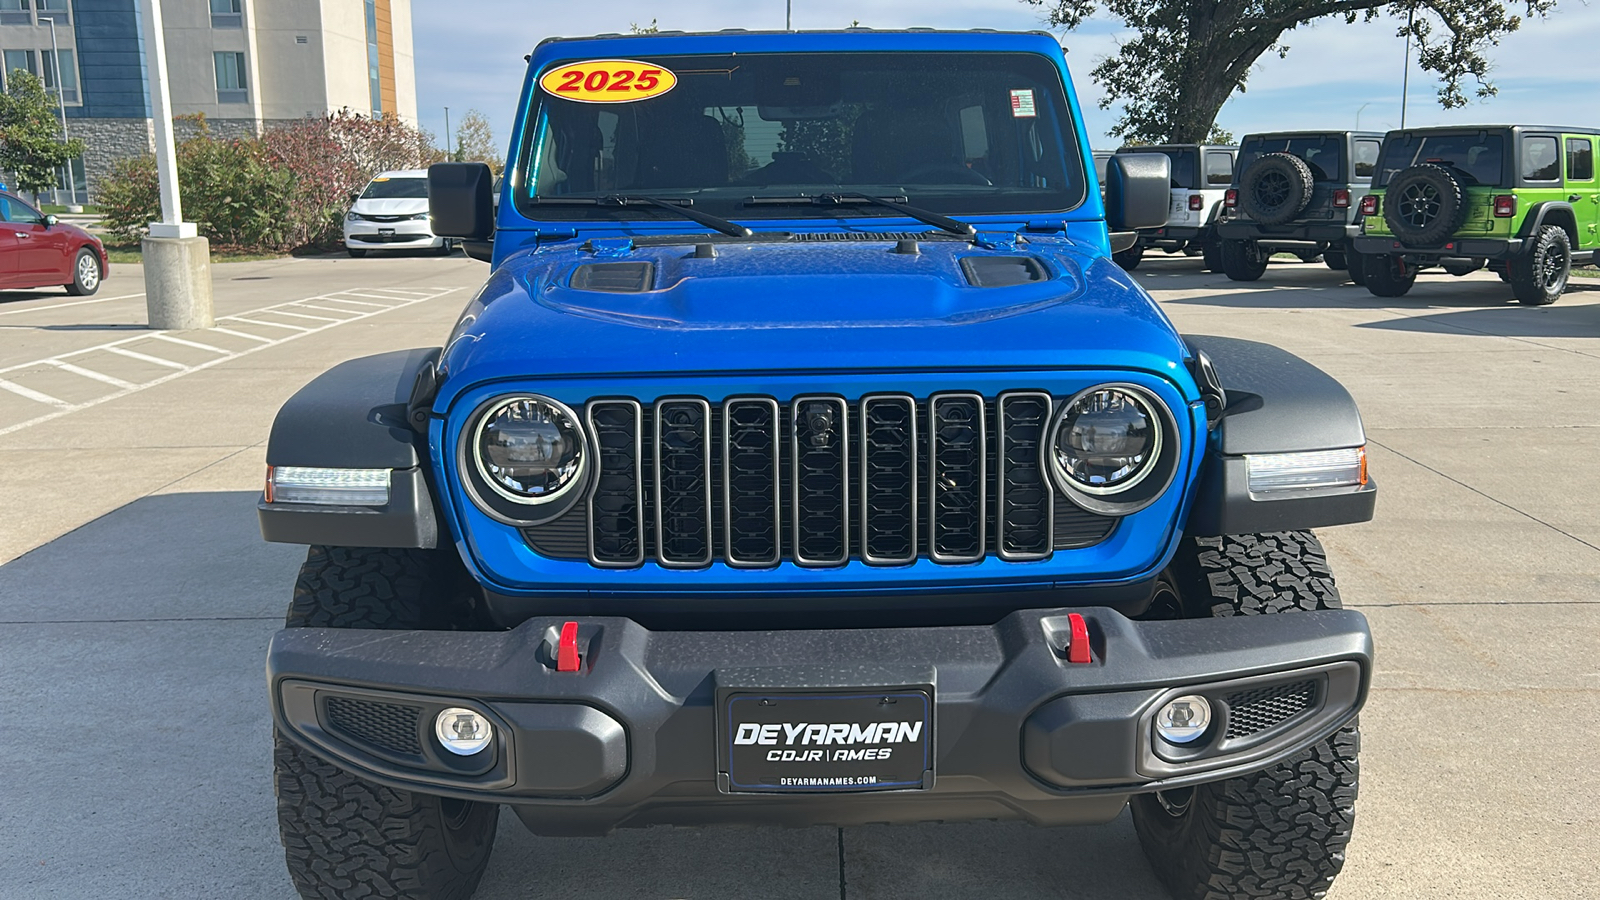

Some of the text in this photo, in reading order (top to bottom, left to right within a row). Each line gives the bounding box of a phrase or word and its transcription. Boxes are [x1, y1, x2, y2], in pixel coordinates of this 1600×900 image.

[556, 69, 662, 92] 2025
[734, 721, 923, 746] DEYARMAN
[766, 748, 893, 762] CDJR AMES
[780, 776, 877, 786] DEYARMANAMES.COM
